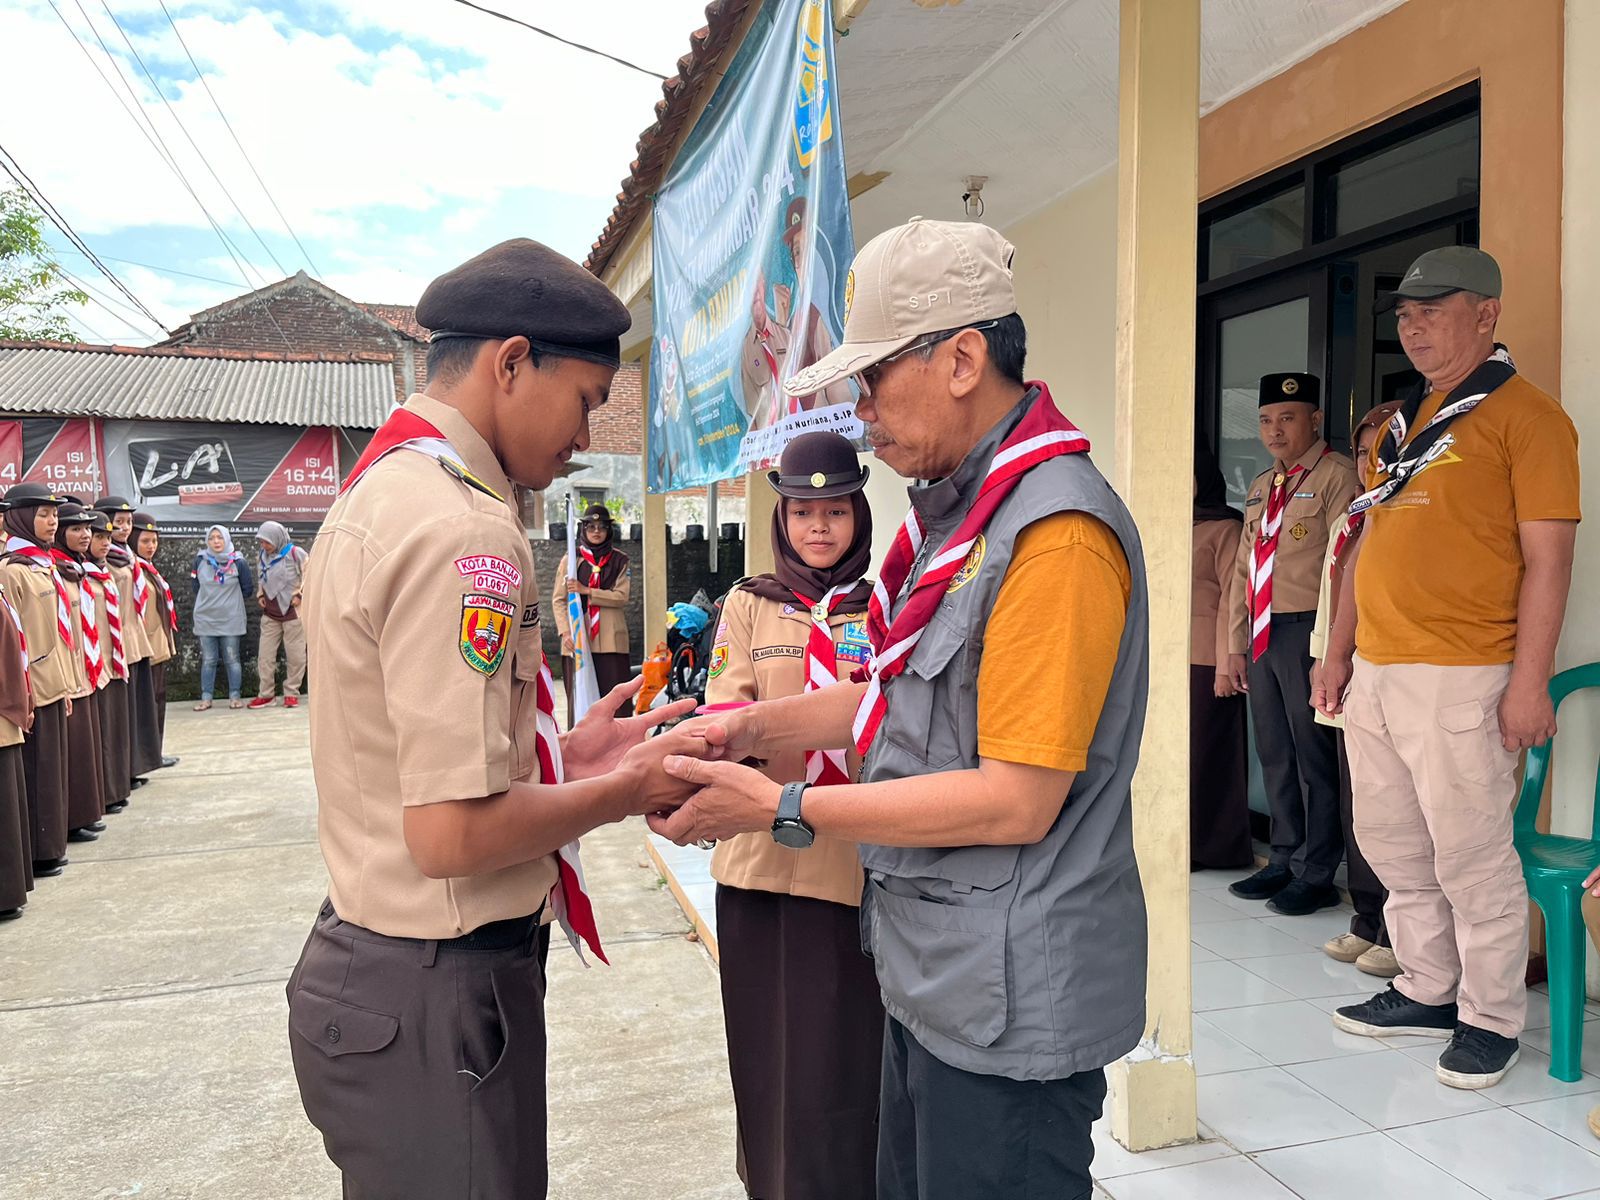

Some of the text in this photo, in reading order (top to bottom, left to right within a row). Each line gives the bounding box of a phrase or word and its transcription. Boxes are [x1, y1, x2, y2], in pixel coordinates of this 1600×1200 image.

[66, 451, 84, 463] ISI
[305, 457, 321, 468] ISI
[286, 485, 336, 495] BATANG
[461, 558, 519, 583] KOTA BANJAR
